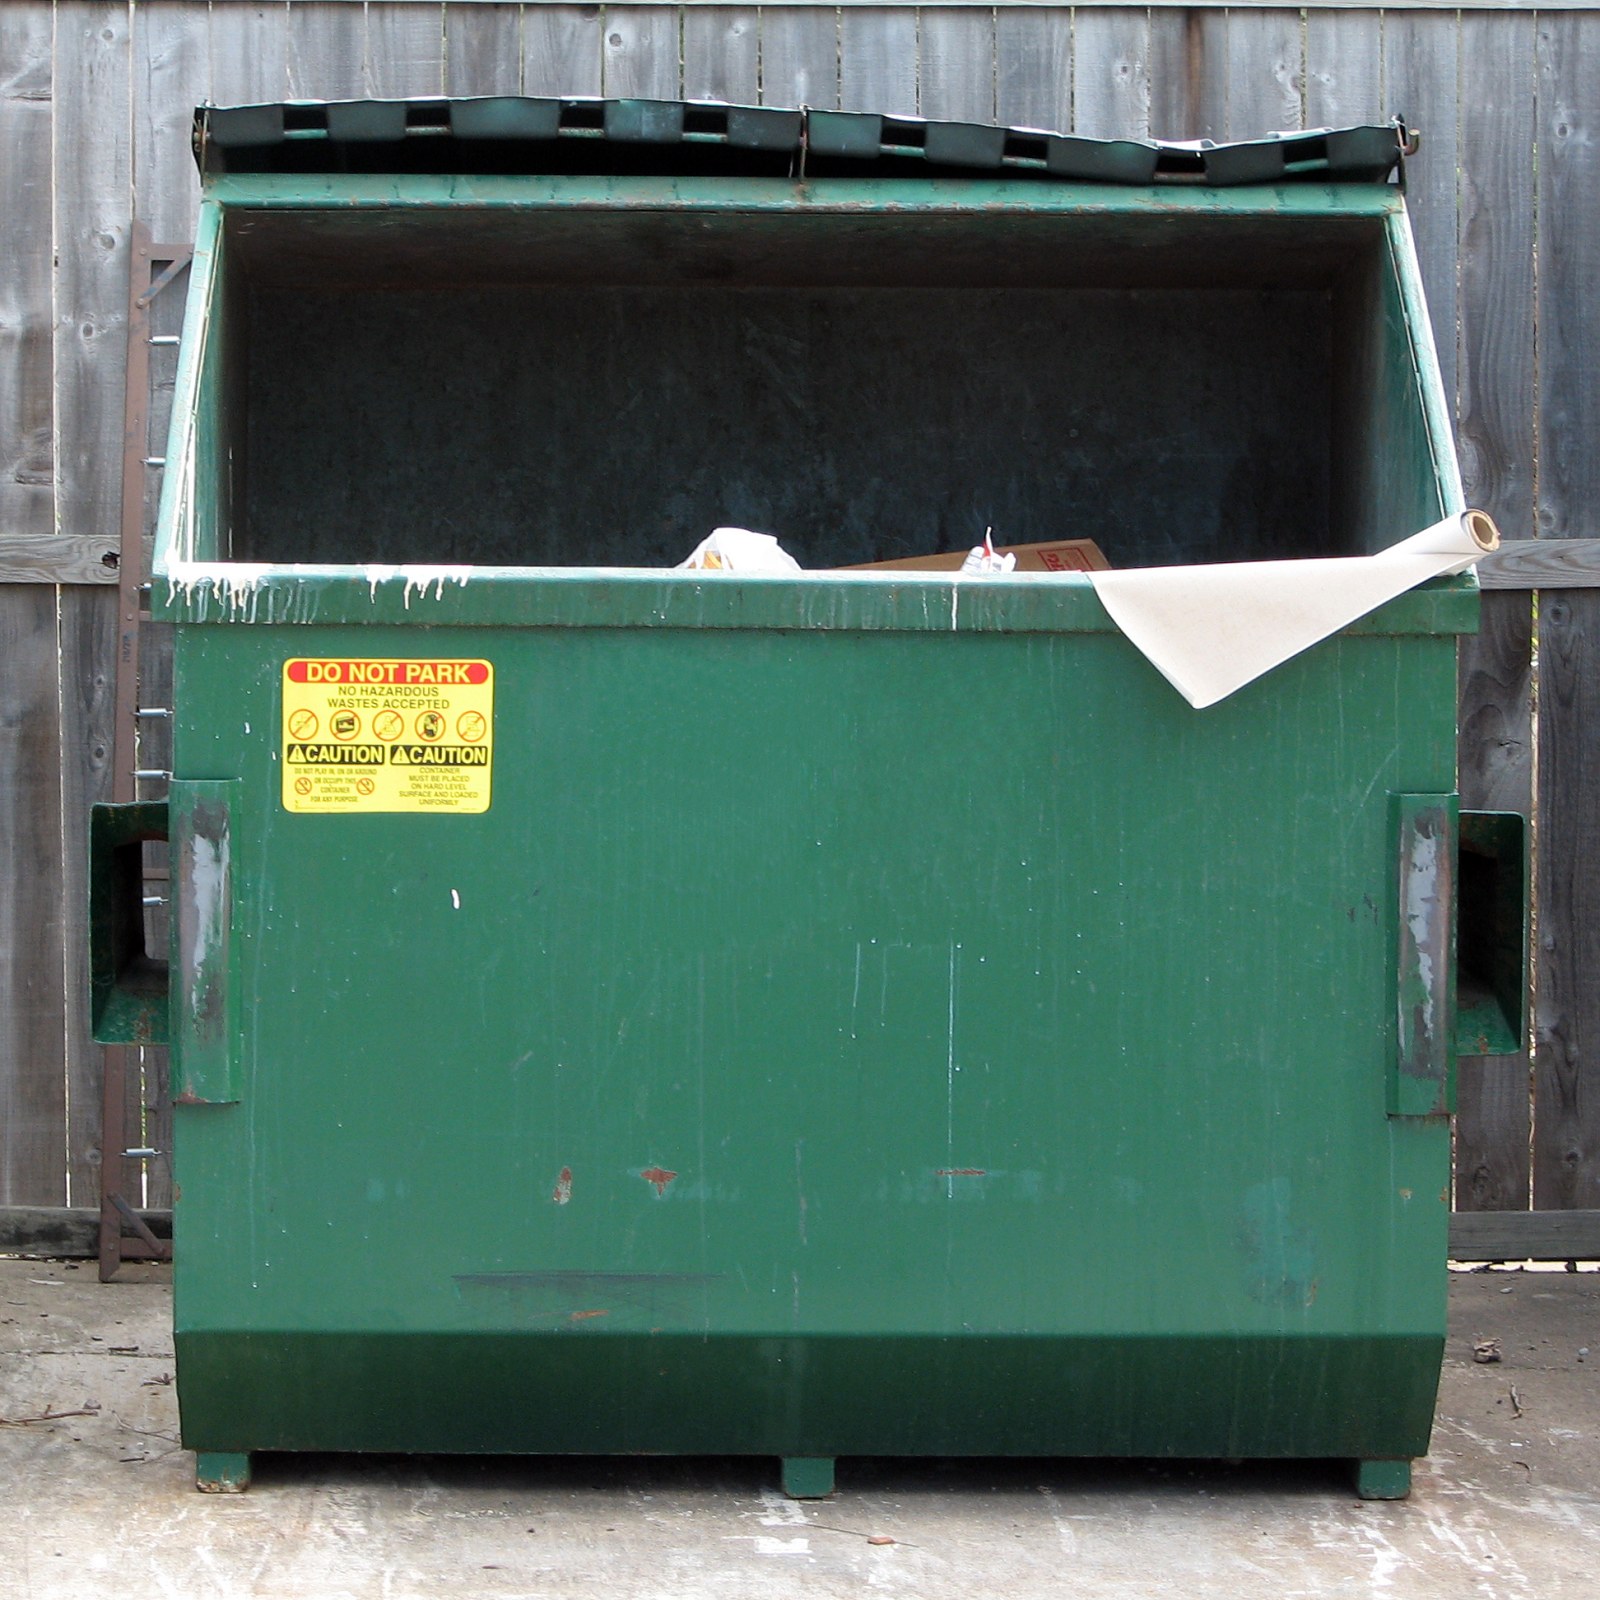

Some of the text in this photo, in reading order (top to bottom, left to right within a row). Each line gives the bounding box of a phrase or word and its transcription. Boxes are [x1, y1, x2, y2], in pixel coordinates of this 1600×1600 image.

[307, 663, 471, 683] DO NOT PARK
[339, 686, 439, 697] NO HAZARDOUS
[327, 698, 449, 709] WASTES ACCEPTED
[306, 745, 383, 763] CAUTION
[410, 746, 486, 764] CAUTION
